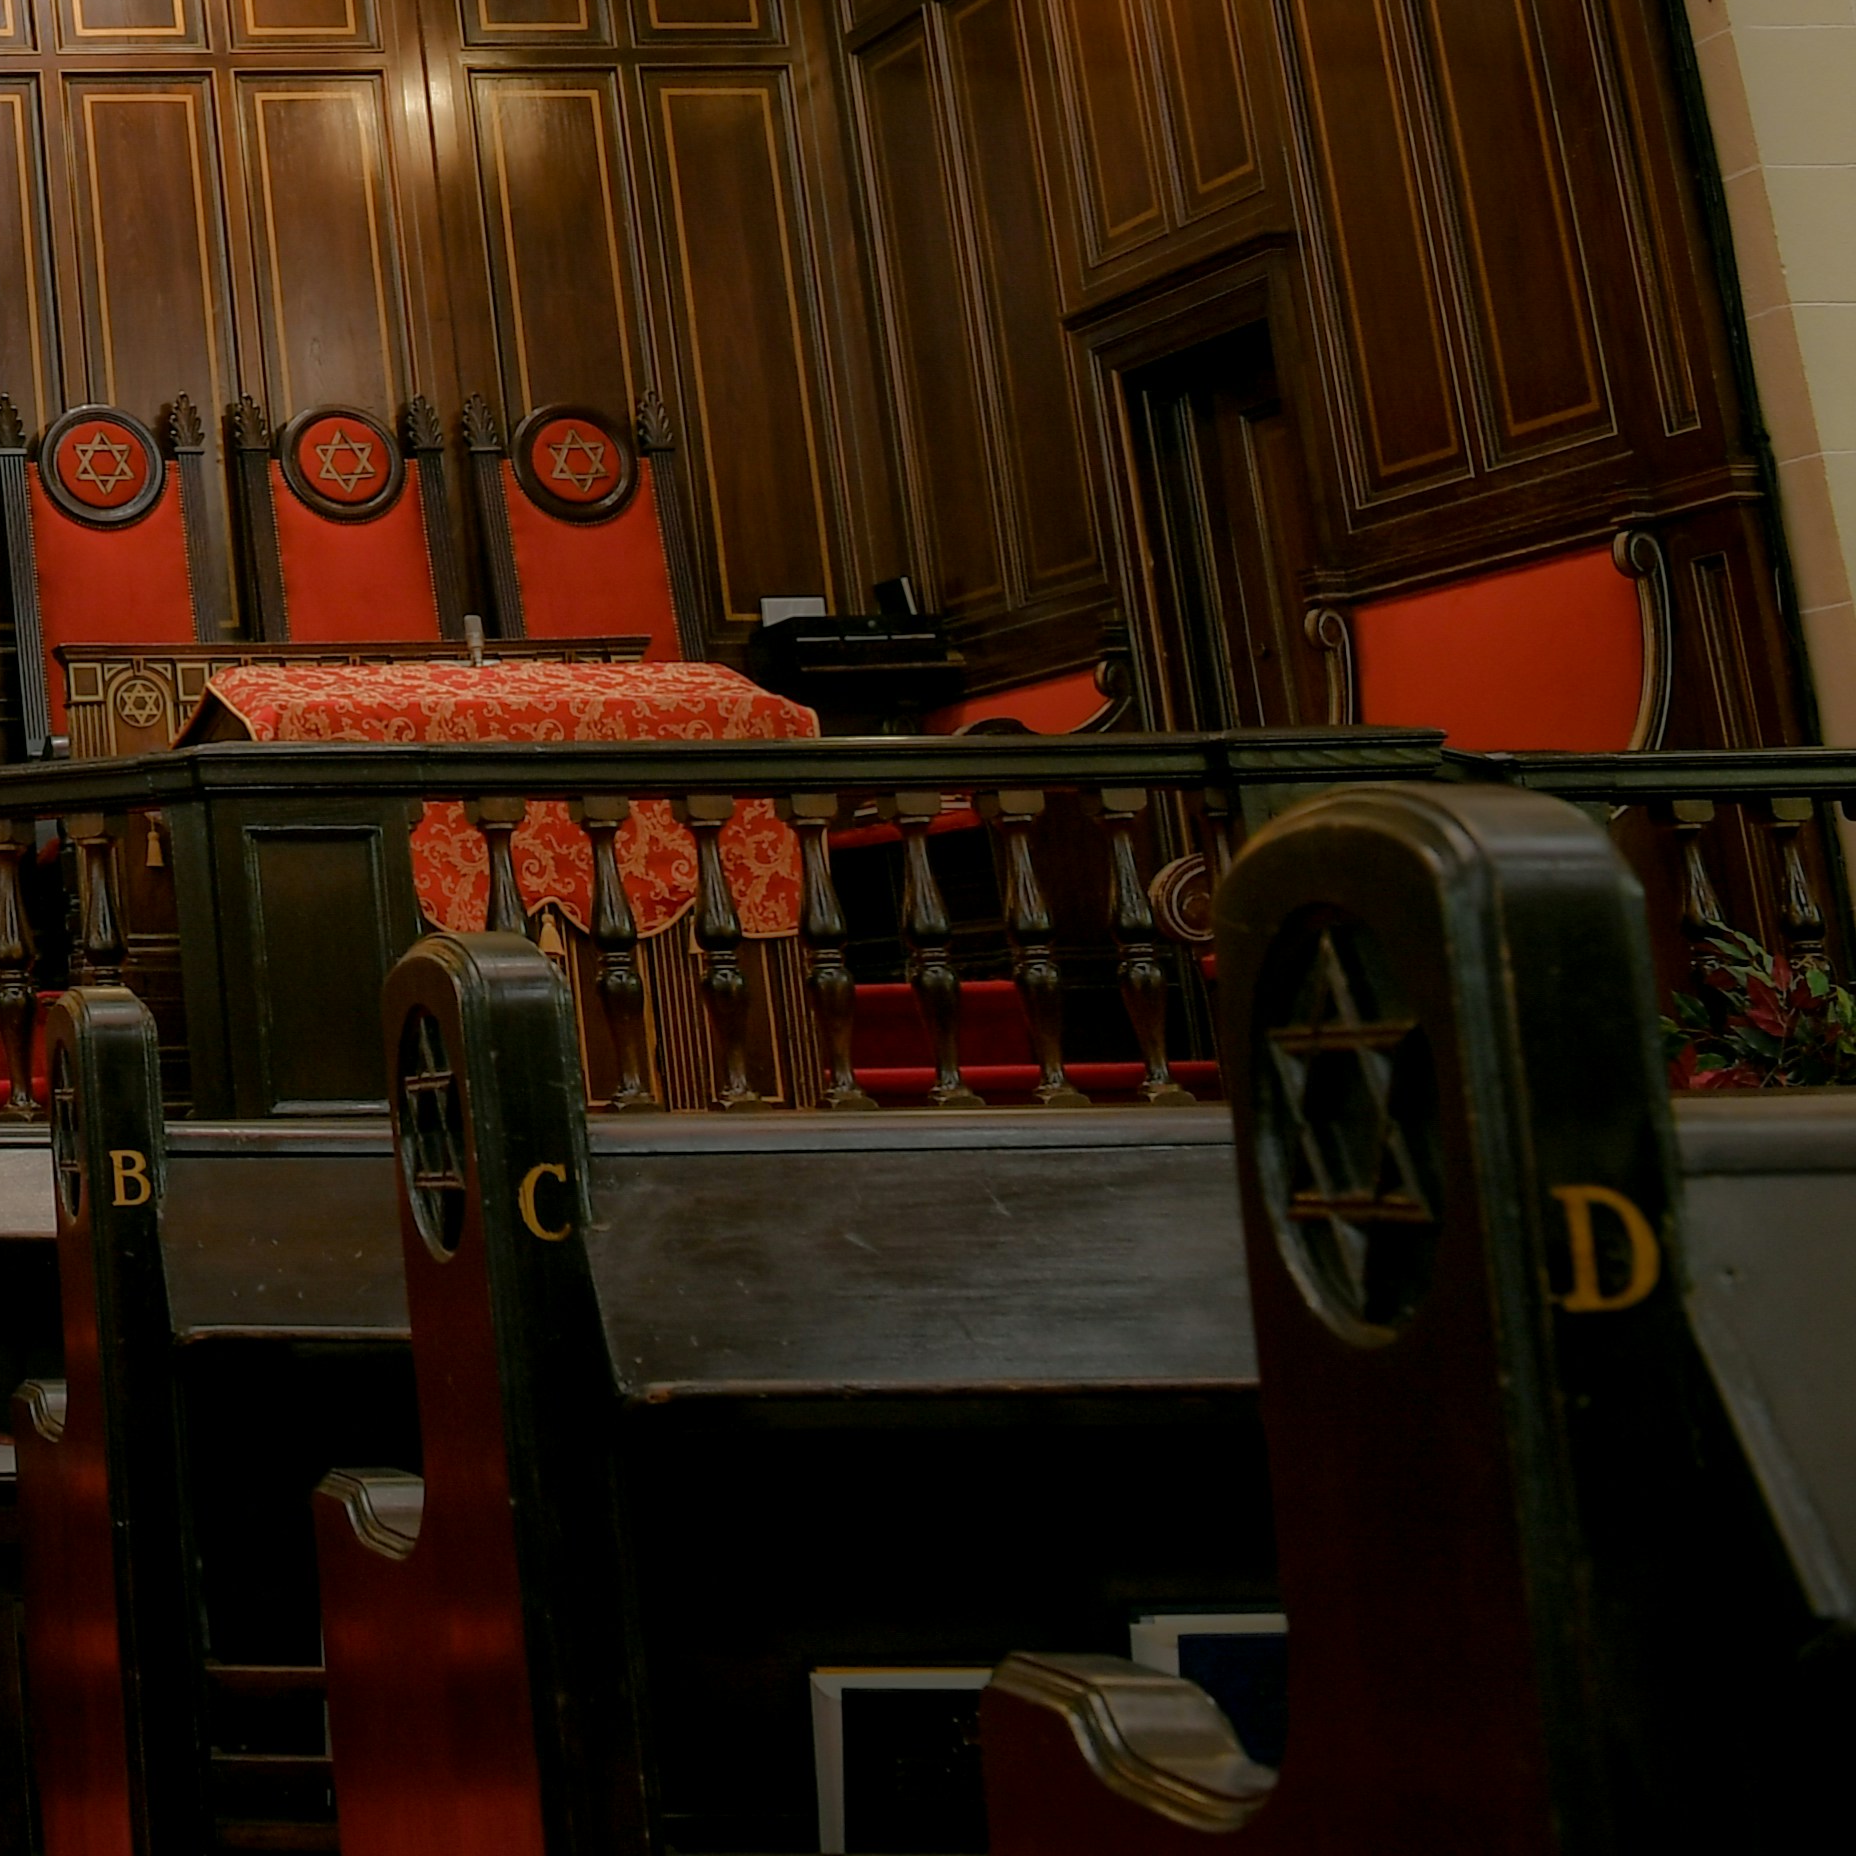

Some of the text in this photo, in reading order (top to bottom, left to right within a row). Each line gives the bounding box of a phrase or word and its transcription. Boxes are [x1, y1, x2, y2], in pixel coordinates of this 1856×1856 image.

[110, 1149, 152, 1207] B
[518, 1162, 573, 1243] C
[1550, 1183, 1662, 1315] D
